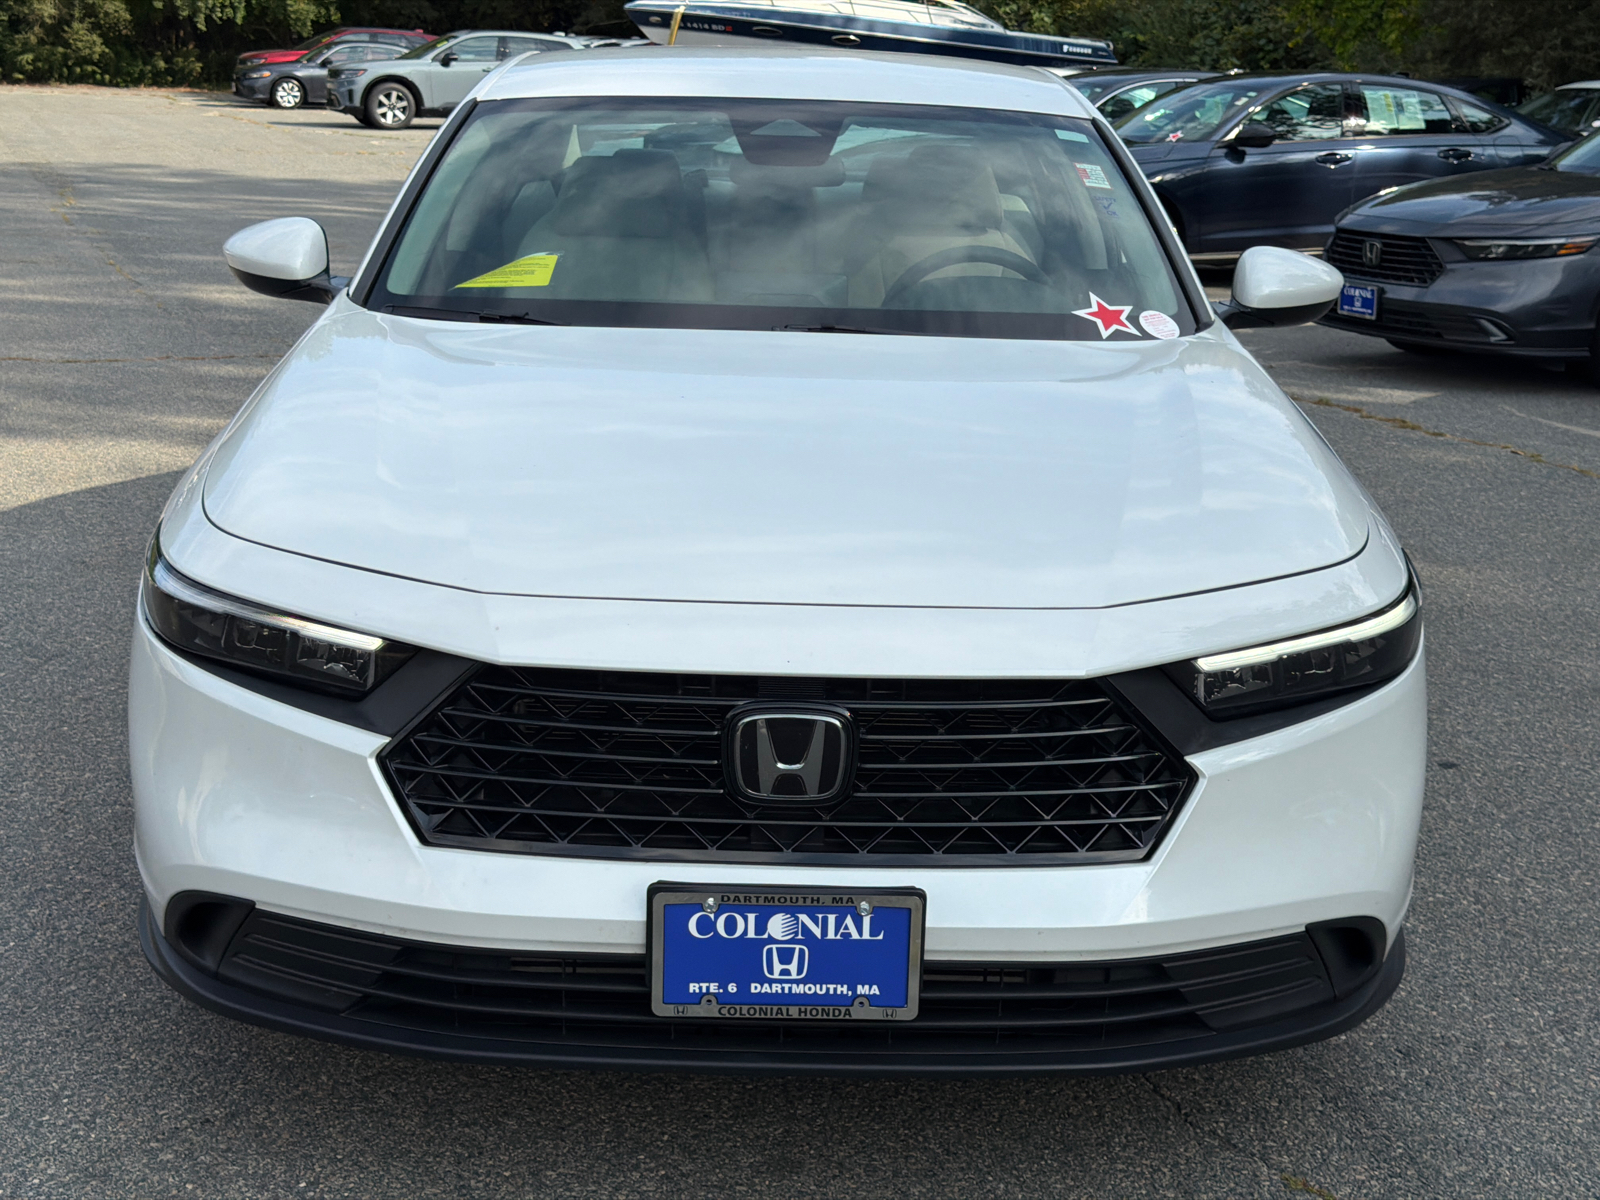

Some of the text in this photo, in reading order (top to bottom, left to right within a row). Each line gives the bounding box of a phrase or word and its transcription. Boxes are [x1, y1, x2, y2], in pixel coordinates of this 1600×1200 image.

[831, 896, 855, 905] MA
[687, 911, 885, 941] COLONIAL
[688, 982, 880, 997] RTE. 6 DARTMOUTH, MA
[717, 1006, 852, 1018] COLONIAL HONDA
